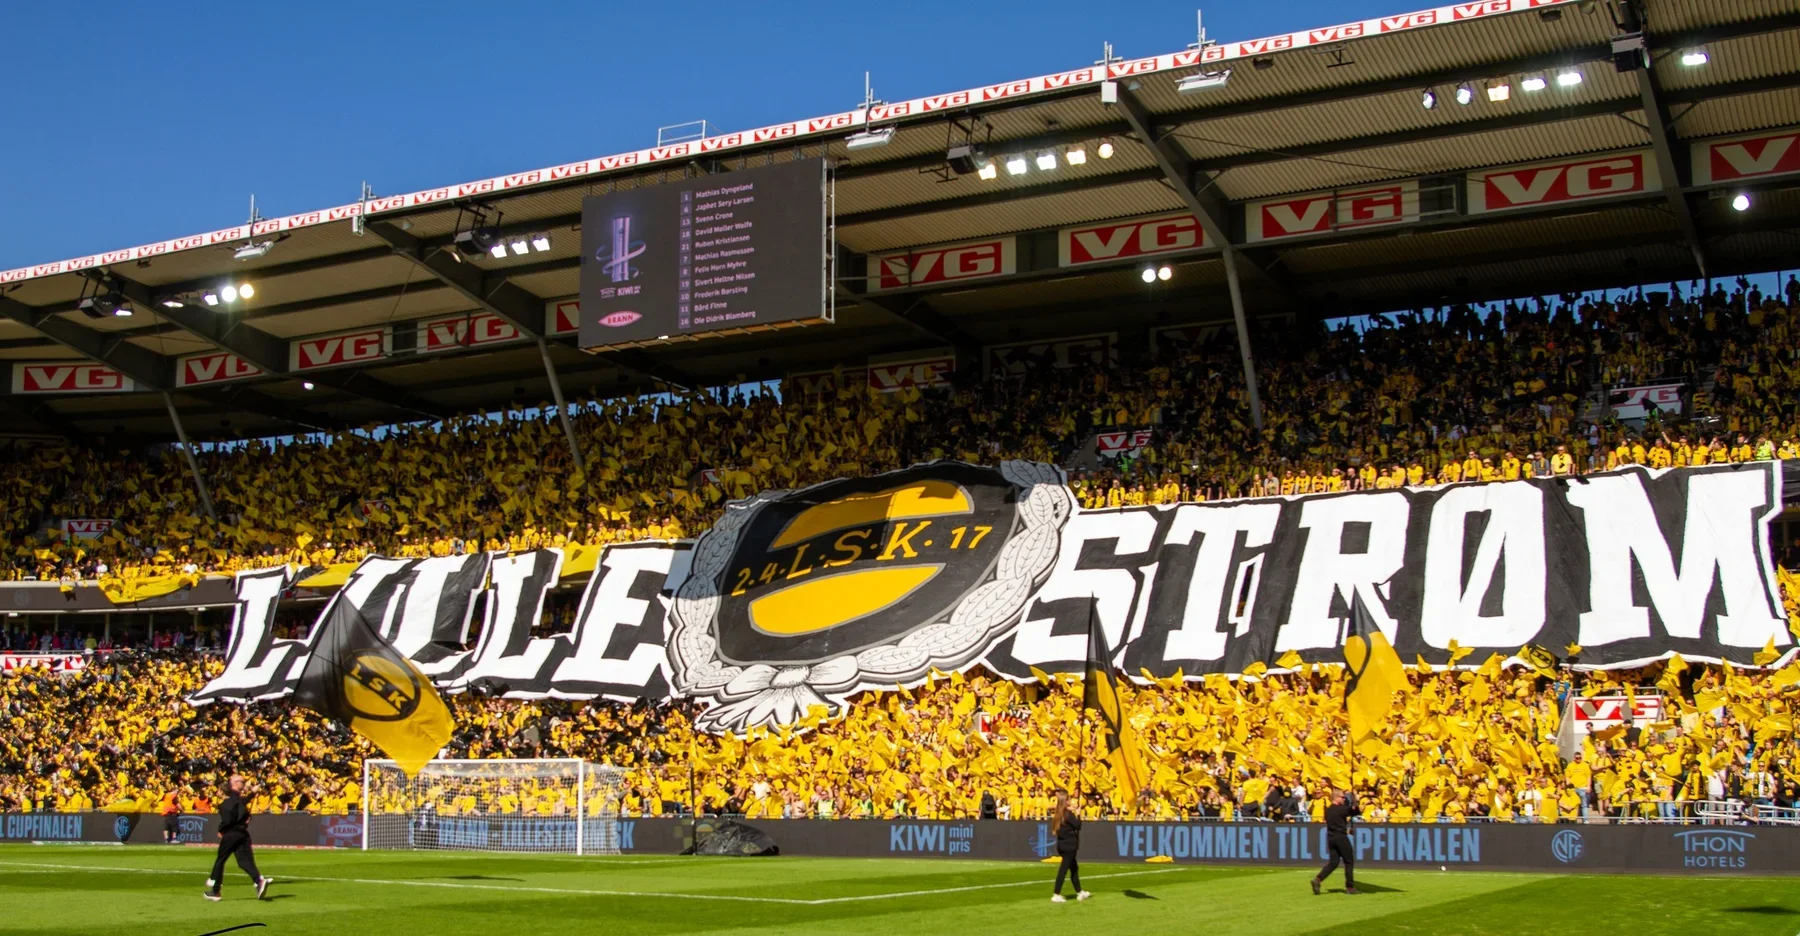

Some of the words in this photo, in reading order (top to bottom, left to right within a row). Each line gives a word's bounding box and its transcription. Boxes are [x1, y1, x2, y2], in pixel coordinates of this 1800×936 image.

[1, 268, 26, 282] VG
[34, 263, 60, 276] VG
[67, 257, 94, 270] VG
[102, 250, 129, 264] VG
[137, 243, 166, 257] VG
[173, 236, 202, 250] VG
[210, 229, 240, 243] VG
[252, 221, 280, 235] VG
[289, 213, 320, 227] VG
[329, 205, 361, 219] VG
[371, 197, 404, 212] VG
[414, 189, 448, 204] VG
[458, 181, 494, 196] VG
[504, 172, 540, 187] VG
[551, 163, 588, 180] VG
[600, 153, 638, 171] VG
[649, 144, 689, 161] VG
[701, 134, 742, 152] VG
[754, 124, 796, 142] VG
[809, 114, 852, 132] VG
[868, 103, 910, 121] VG
[923, 92, 969, 111] VG
[983, 81, 1030, 99] VG
[1044, 70, 1093, 88] VG
[1108, 59, 1158, 77] VG
[1173, 46, 1225, 67] VG
[1240, 36, 1293, 55] VG
[1309, 24, 1364, 44] VG
[1380, 11, 1437, 32] VG
[1453, 1, 1511, 20] VG
[1489, 159, 1635, 205] VG
[695, 189, 720, 199] Mathias
[721, 183, 753, 195] Dyngeland
[695, 201, 717, 211] Japhet
[733, 196, 754, 205] Larsen
[1266, 190, 1393, 233] VG
[715, 212, 733, 220] Crone
[695, 227, 713, 236] David
[1074, 217, 1196, 260] VG
[695, 240, 714, 248] Ruben
[715, 235, 750, 245] Kristiansen
[695, 252, 719, 260] Mathias
[720, 247, 754, 257] Rasmussen
[727, 261, 747, 270] Myhre
[882, 245, 995, 285] VG
[694, 278, 713, 287] Sivert
[735, 272, 755, 280] Nilsen
[694, 290, 720, 298] Frederik
[607, 314, 633, 324] BRANN
[706, 314, 724, 323] Didrik
[725, 311, 756, 320] Blomberg
[430, 316, 516, 345] VG
[302, 333, 380, 366] VG
[28, 366, 118, 390] VG
[70, 521, 109, 532] VG
[1010, 469, 1791, 664] STRØM
[1575, 699, 1659, 719] VG
[8, 815, 82, 838] CUPFINALEN
[333, 827, 358, 835] BRANN
[949, 824, 974, 839] mini
[891, 825, 945, 851] KIWI
[1116, 825, 1268, 859] VELKOMMEN
[1276, 827, 1312, 859] TIL
[1674, 829, 1755, 852] THON
[949, 839, 970, 855] pris
[1684, 855, 1746, 868] HOTELS
